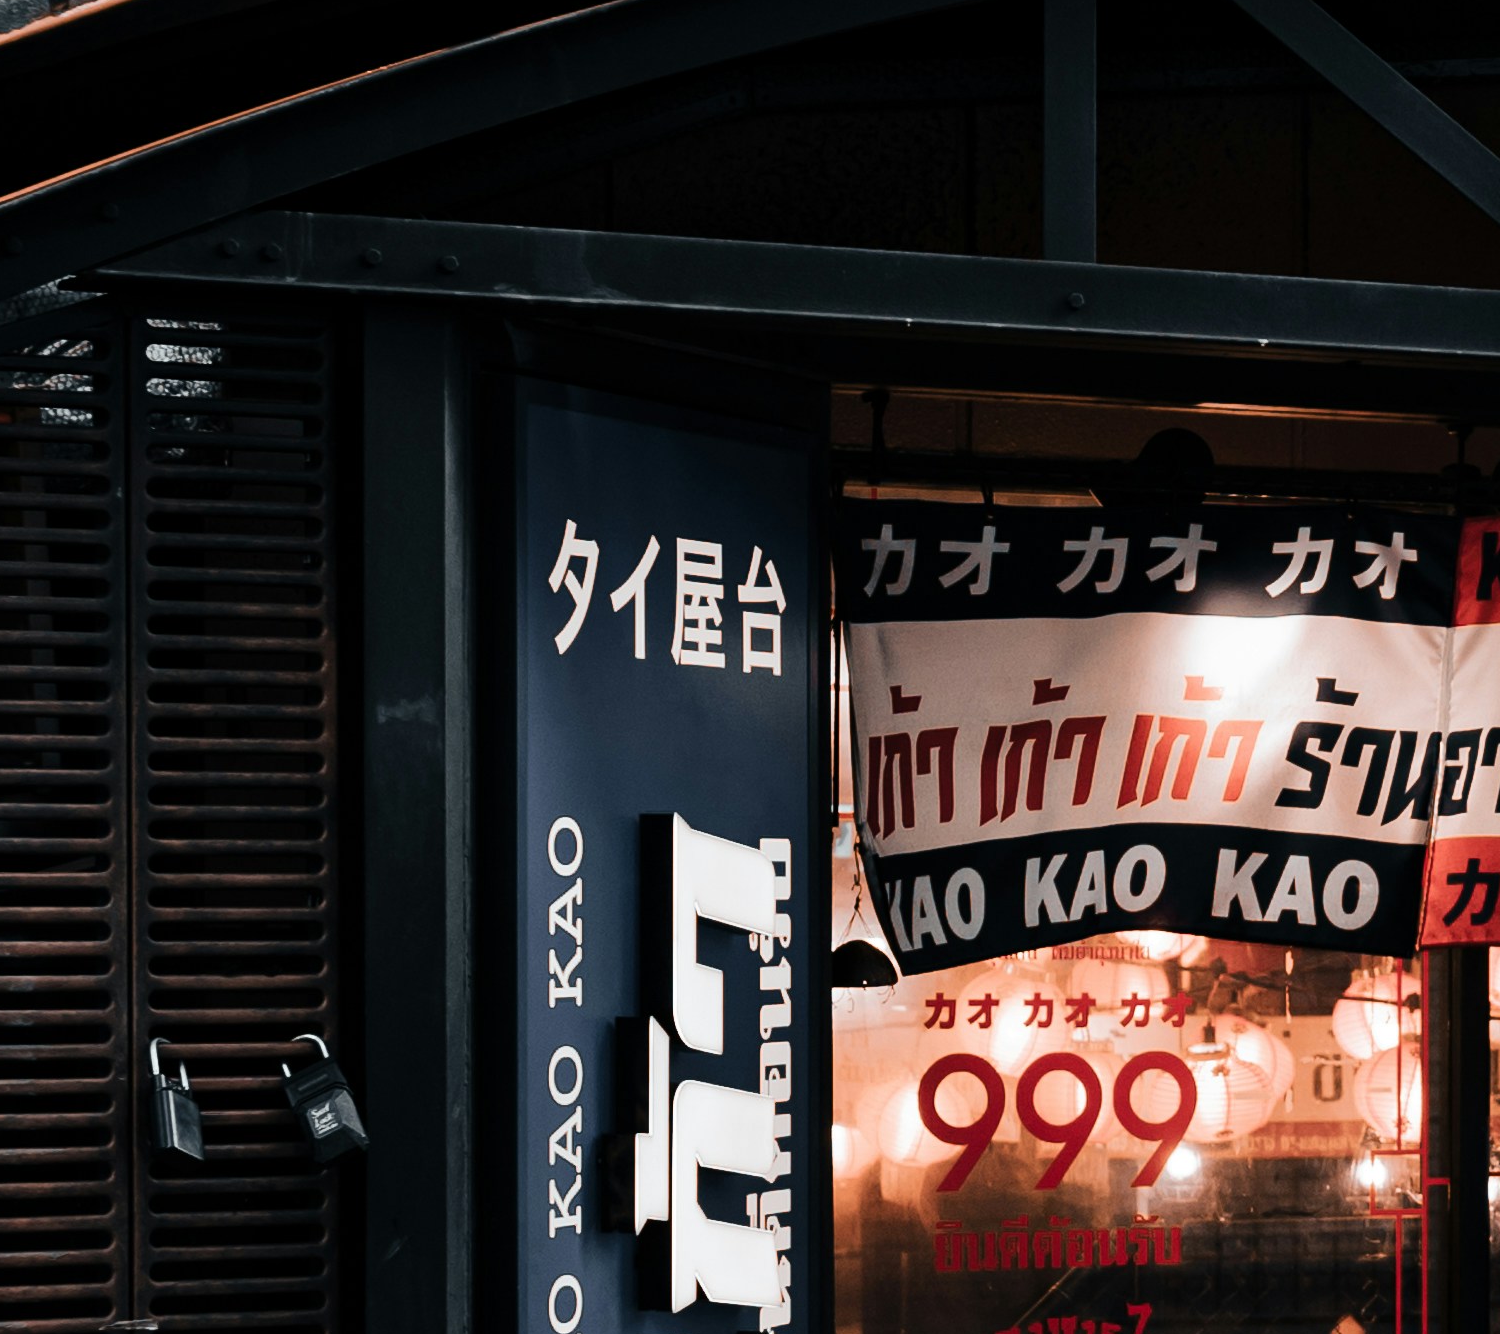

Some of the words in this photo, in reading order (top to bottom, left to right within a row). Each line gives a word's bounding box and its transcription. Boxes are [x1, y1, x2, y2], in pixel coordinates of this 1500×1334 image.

[548, 519, 786, 677] タイ屋台
[861, 524, 1009, 597] カオ
[1056, 524, 1217, 594] カオ
[1265, 526, 1417, 600] カオ
[867, 685, 958, 840] เก้า
[979, 678, 1106, 827] เก้า
[1117, 675, 1264, 809] เก้า
[547, 816, 583, 1008] KAO
[885, 867, 985, 952] KAO
[1025, 844, 1165, 927] KAO
[1211, 849, 1380, 930] KAO
[924, 992, 999, 1030] カオ
[1023, 991, 1096, 1029] カオ
[1120, 991, 1193, 1029] カオ
[547, 1045, 583, 1239] KAO
[918, 1051, 1198, 1192] 999
[933, 1214, 1183, 1272] ยินดีต้อนรับ
